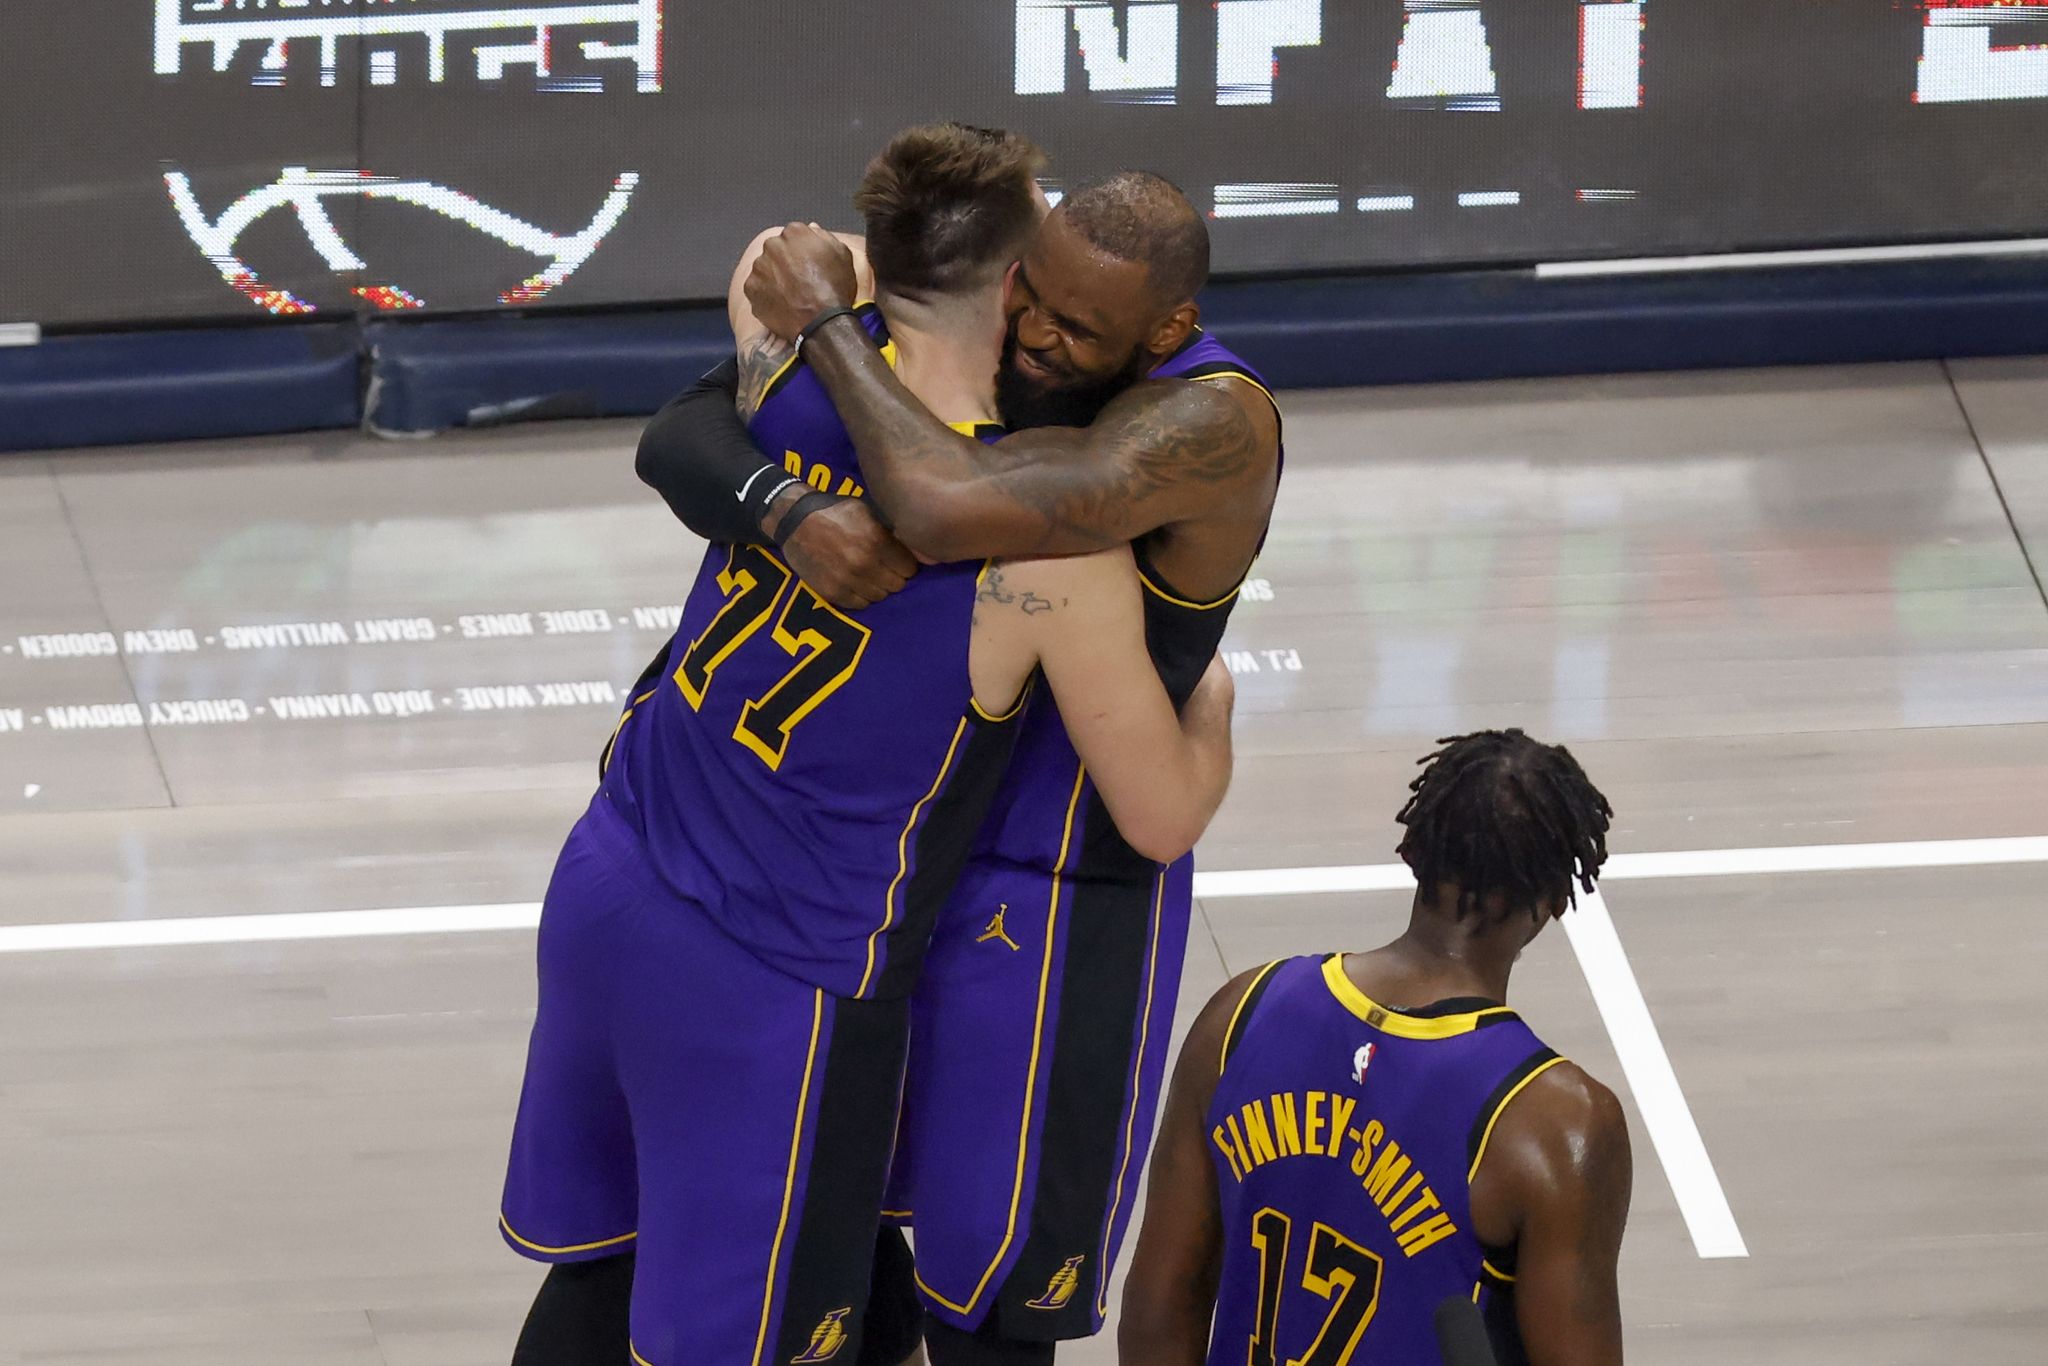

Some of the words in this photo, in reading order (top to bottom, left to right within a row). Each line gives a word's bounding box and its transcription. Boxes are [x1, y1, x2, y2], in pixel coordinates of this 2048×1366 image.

[354, 617, 436, 643] GRANT
[458, 612, 534, 638] JONES
[539, 609, 613, 634] EDDIE
[18, 632, 118, 657] GOODEN
[124, 628, 198, 653] DREW
[220, 621, 349, 649] WILLIAMS
[672, 543, 872, 772] 77
[269, 694, 371, 719] VIANNA
[456, 685, 536, 711] WADE
[536, 681, 616, 706] MARK
[46, 703, 144, 730] BROWN
[149, 698, 250, 725] CHUCKY
[1212, 1090, 1458, 1259] FINNEY-SMITH
[1247, 1206, 1384, 1366] 17
